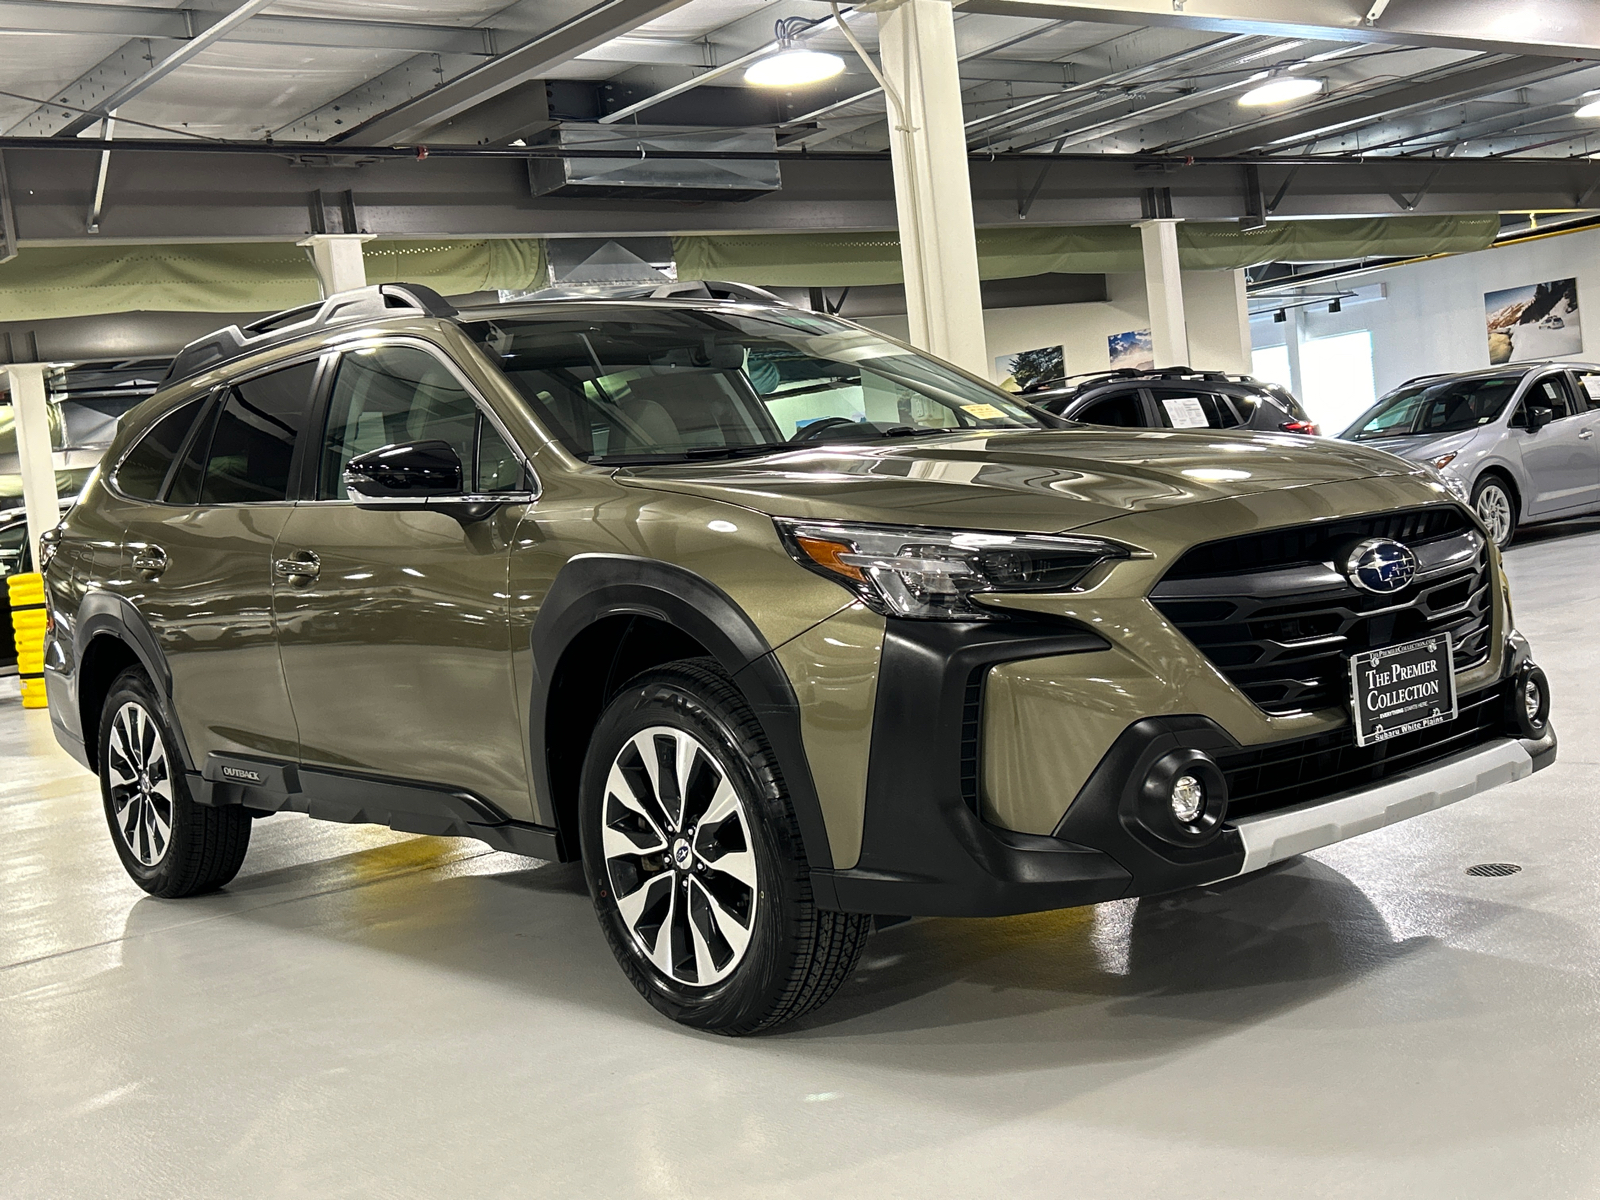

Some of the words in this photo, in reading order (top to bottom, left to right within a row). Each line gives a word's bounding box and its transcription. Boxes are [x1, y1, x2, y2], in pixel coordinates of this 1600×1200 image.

[1365, 669, 1391, 690] THE
[1391, 659, 1438, 683] PREMIER
[1366, 680, 1439, 712] COLLECTION
[1379, 707, 1405, 719] EVERYTHING
[1374, 728, 1400, 741] Subaru
[1401, 721, 1422, 734] White
[1422, 715, 1444, 727] Plains
[223, 766, 260, 780] OUTBACK
